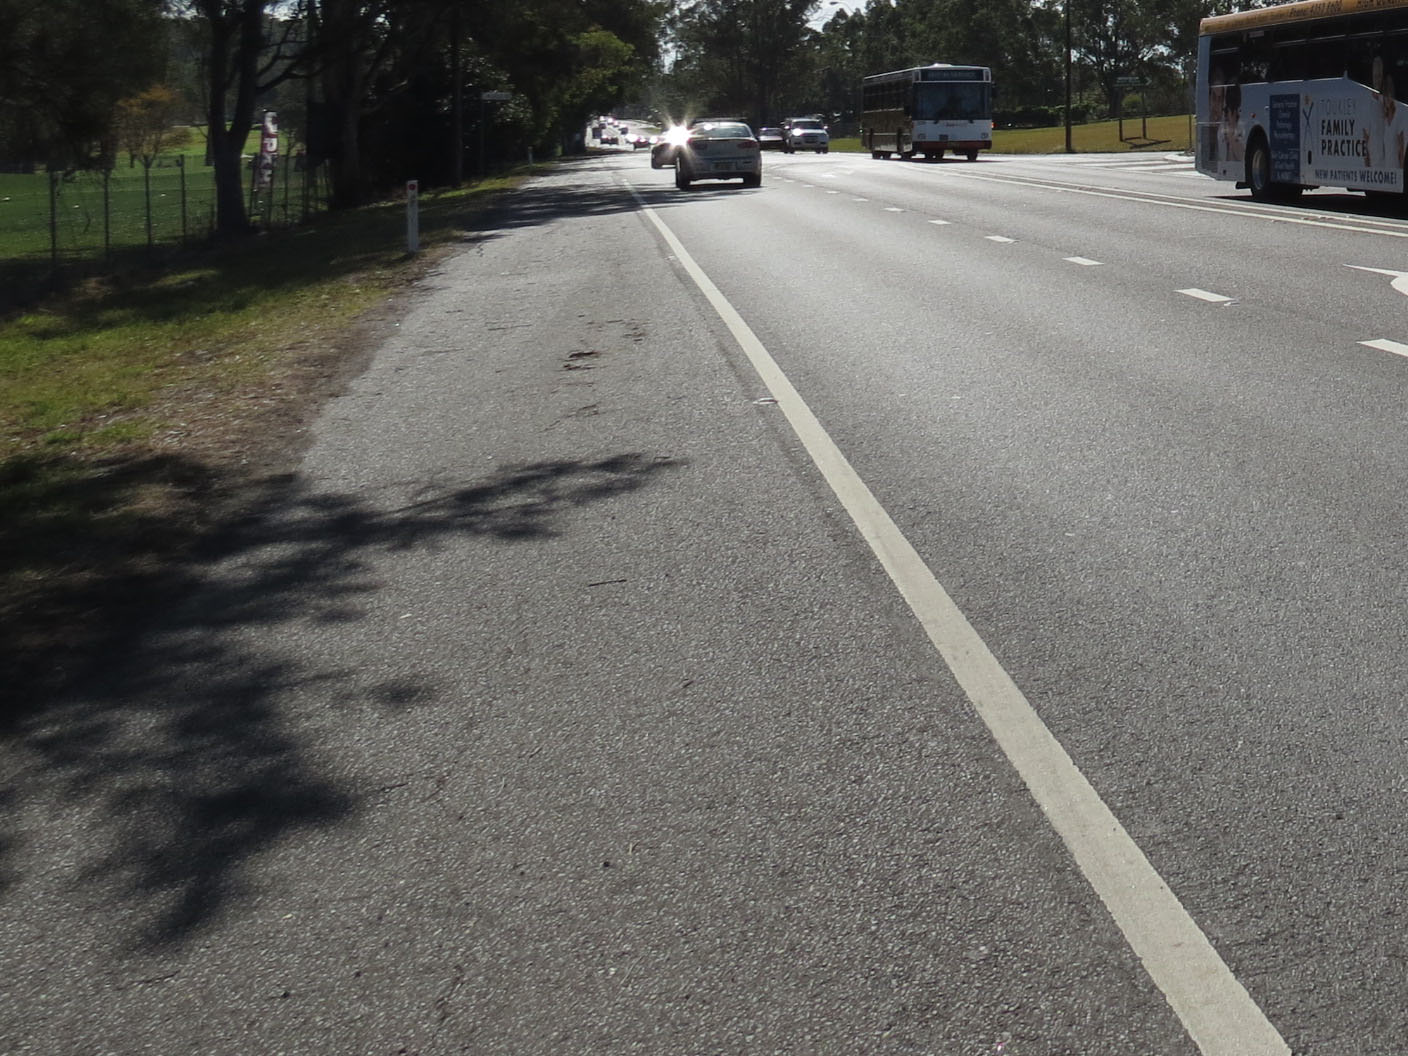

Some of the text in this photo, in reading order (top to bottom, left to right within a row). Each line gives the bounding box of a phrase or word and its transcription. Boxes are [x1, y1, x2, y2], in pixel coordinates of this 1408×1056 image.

[1320, 119, 1355, 136] FAMILY
[1320, 139, 1368, 157] PRACTICE
[1315, 169, 1397, 185] NEW PATIENTS WELCOME!
